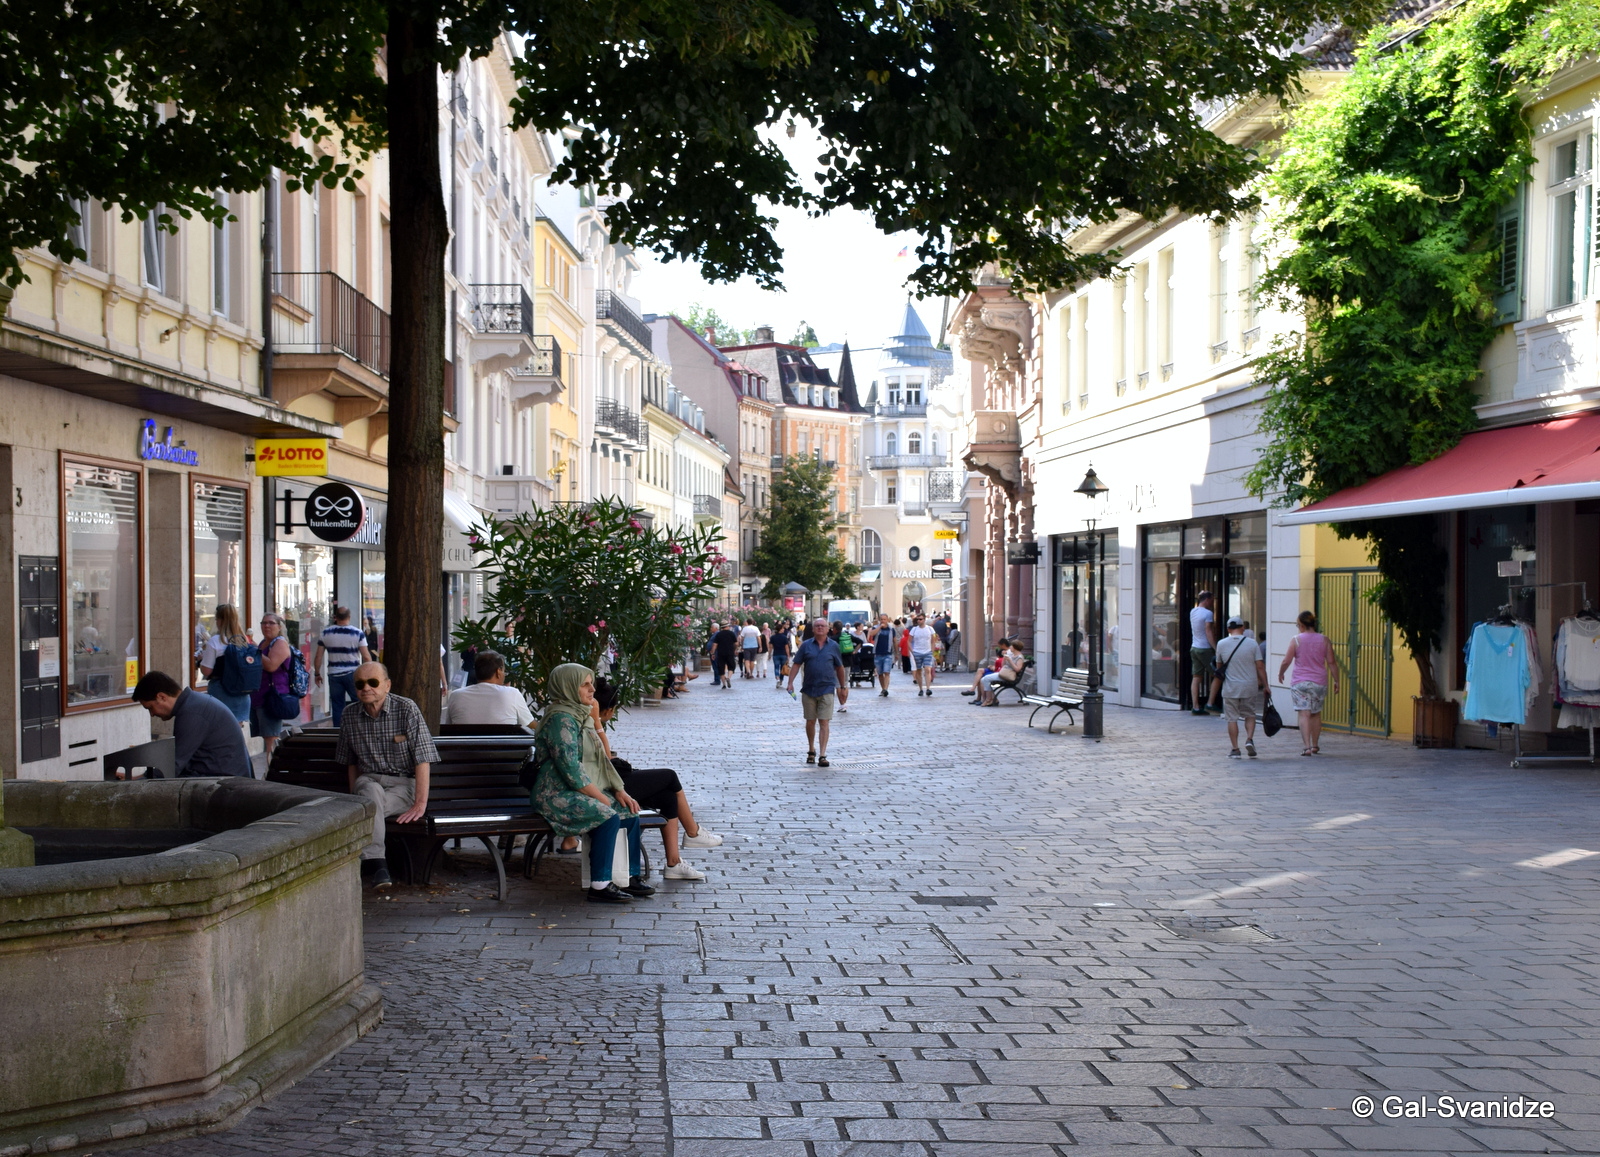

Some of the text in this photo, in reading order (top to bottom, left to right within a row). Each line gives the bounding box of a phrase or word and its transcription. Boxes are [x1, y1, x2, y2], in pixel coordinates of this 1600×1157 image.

[278, 448, 325, 460] LOTTO
[15, 487, 23, 507] 3
[310, 518, 358, 528] hunkemöller
